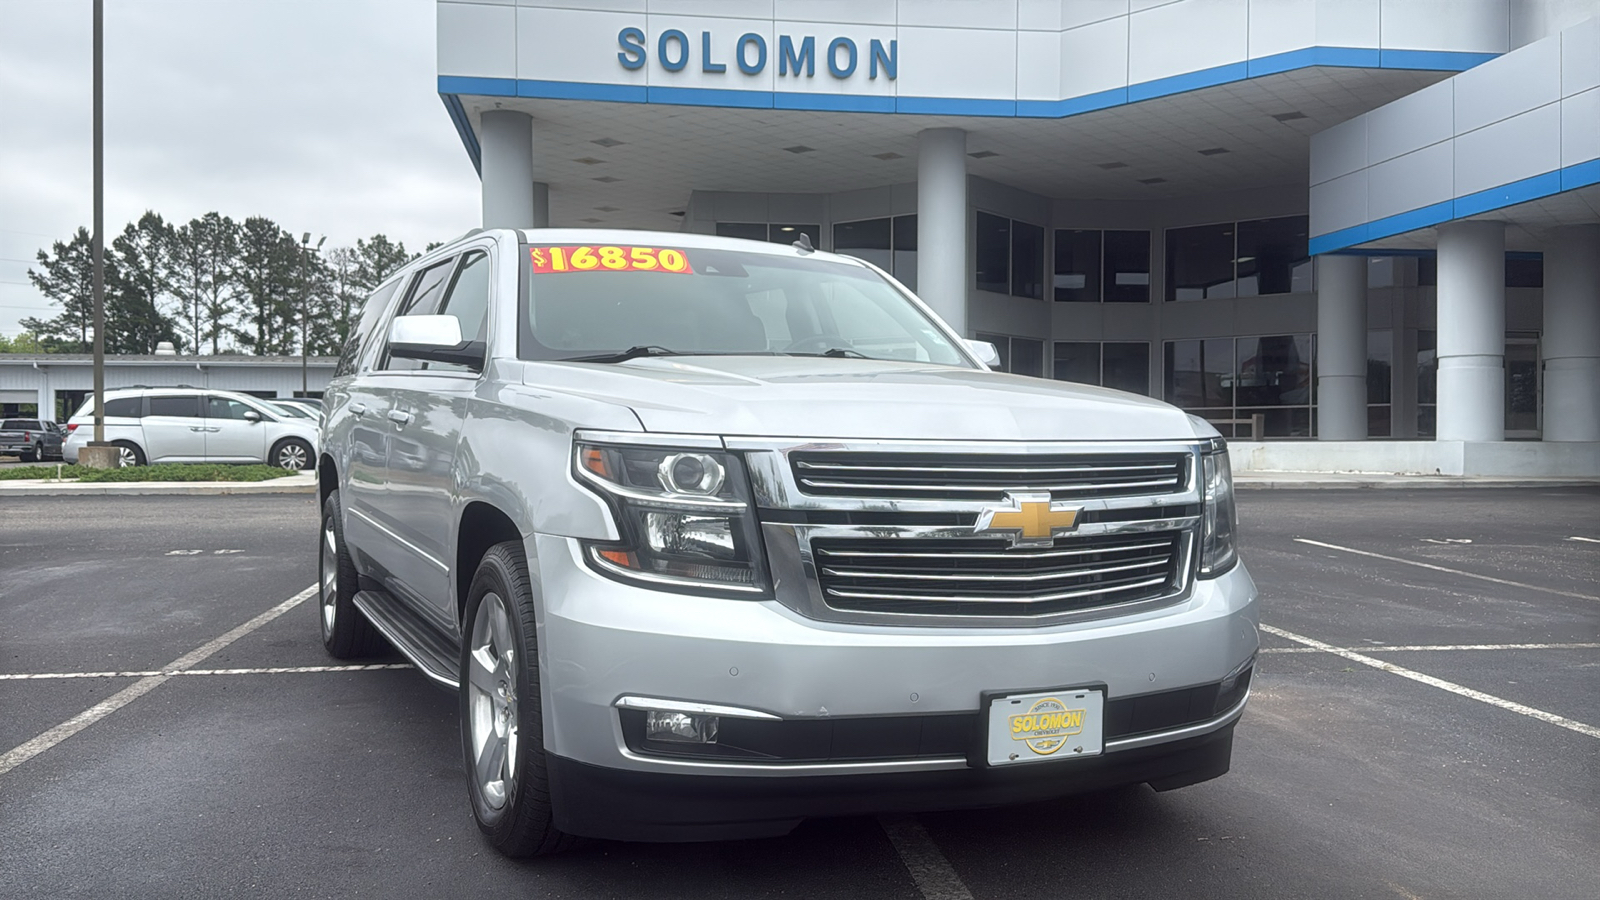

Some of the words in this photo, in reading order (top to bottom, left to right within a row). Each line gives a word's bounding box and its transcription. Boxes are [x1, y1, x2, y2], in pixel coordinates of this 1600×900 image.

[617, 27, 898, 80] SOLOMON
[531, 246, 687, 271] $16850
[1012, 712, 1082, 733] SOLOMON
